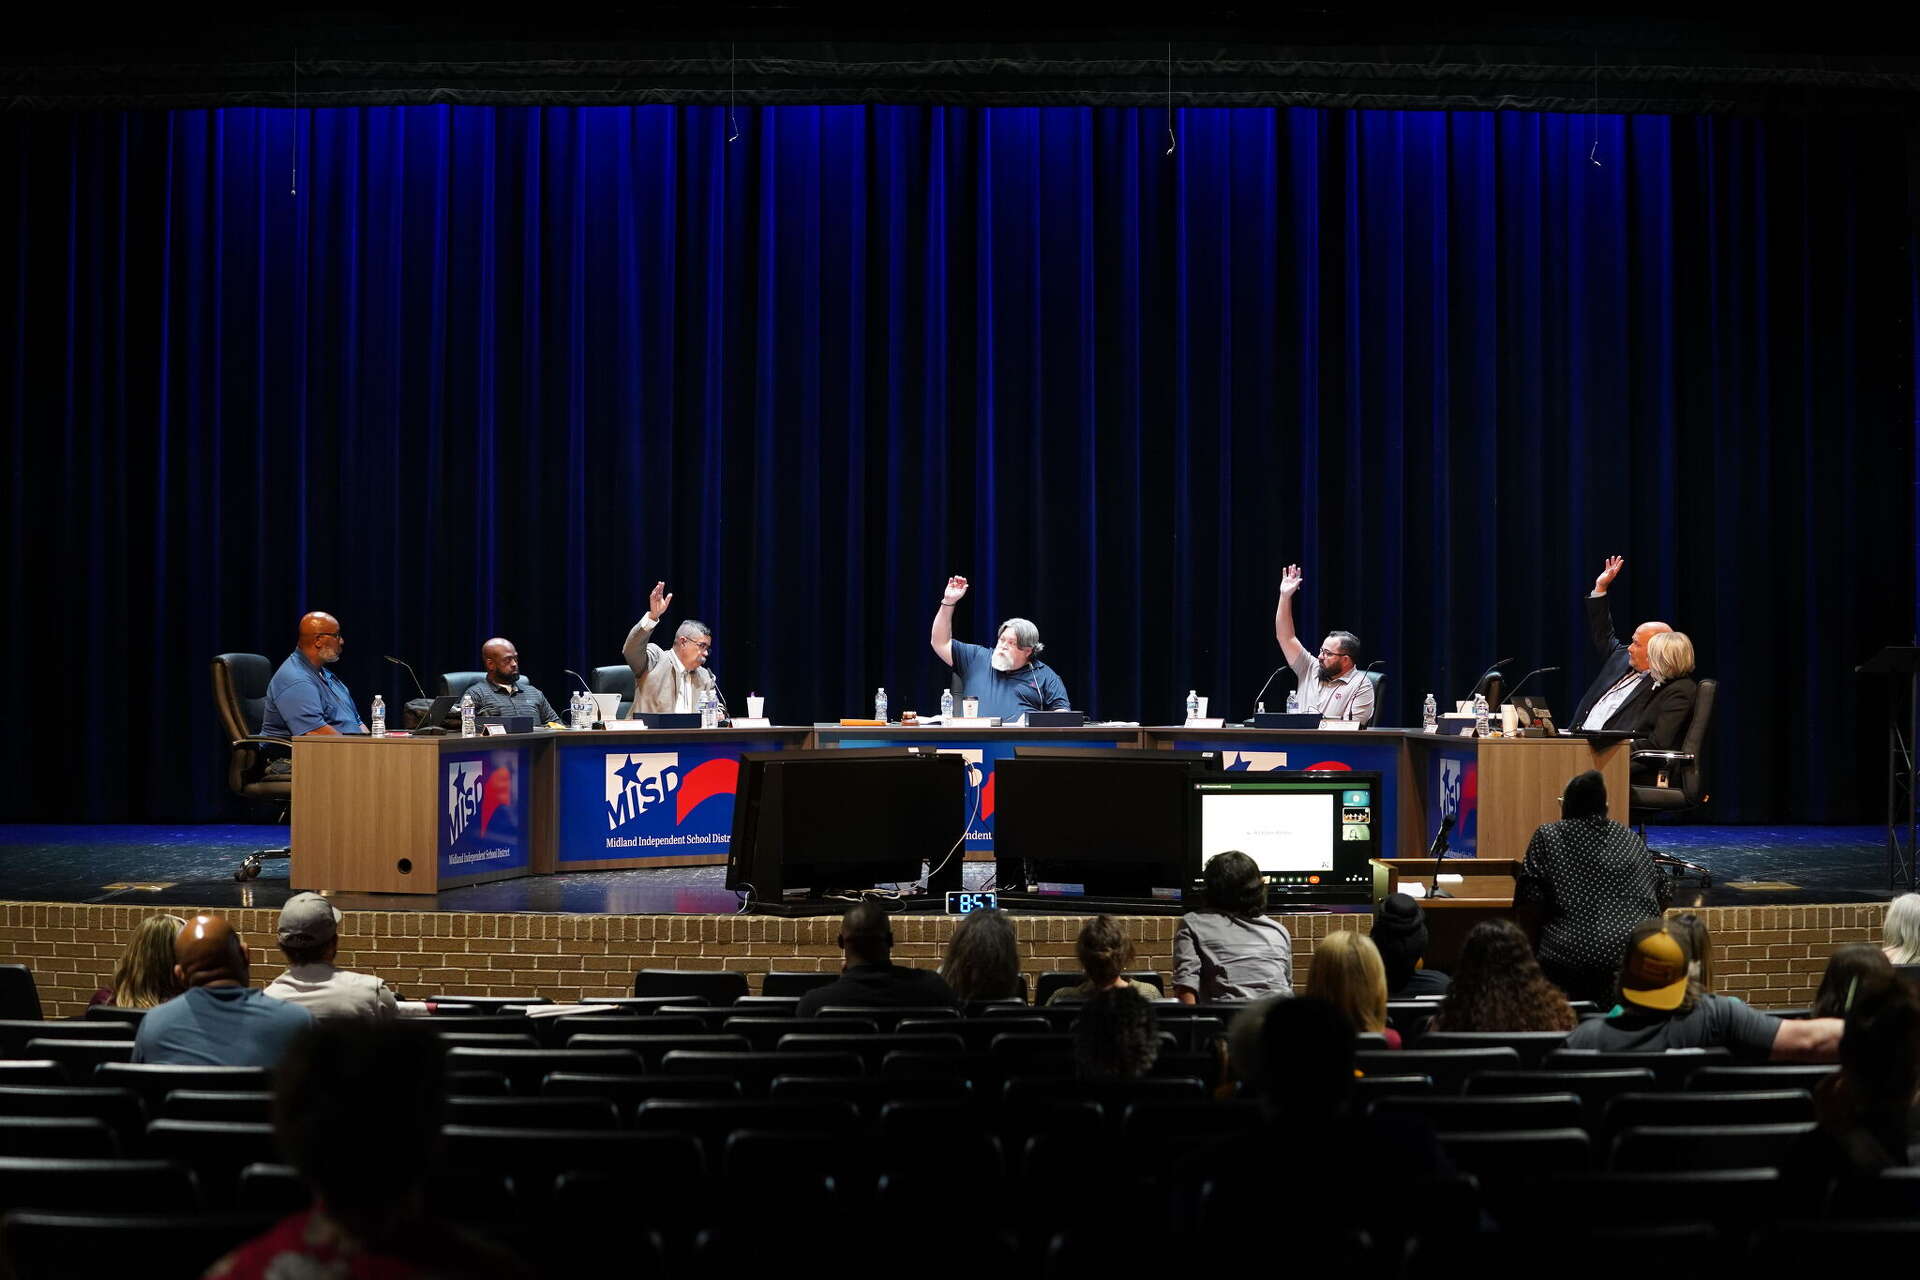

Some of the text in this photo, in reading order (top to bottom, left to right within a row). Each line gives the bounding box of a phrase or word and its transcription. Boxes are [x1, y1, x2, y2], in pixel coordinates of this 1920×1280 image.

[448, 775, 483, 846] MISD
[606, 765, 682, 830] MISD
[606, 833, 731, 848] Midland Independent School Distr
[960, 894, 996, 913] 8:57
